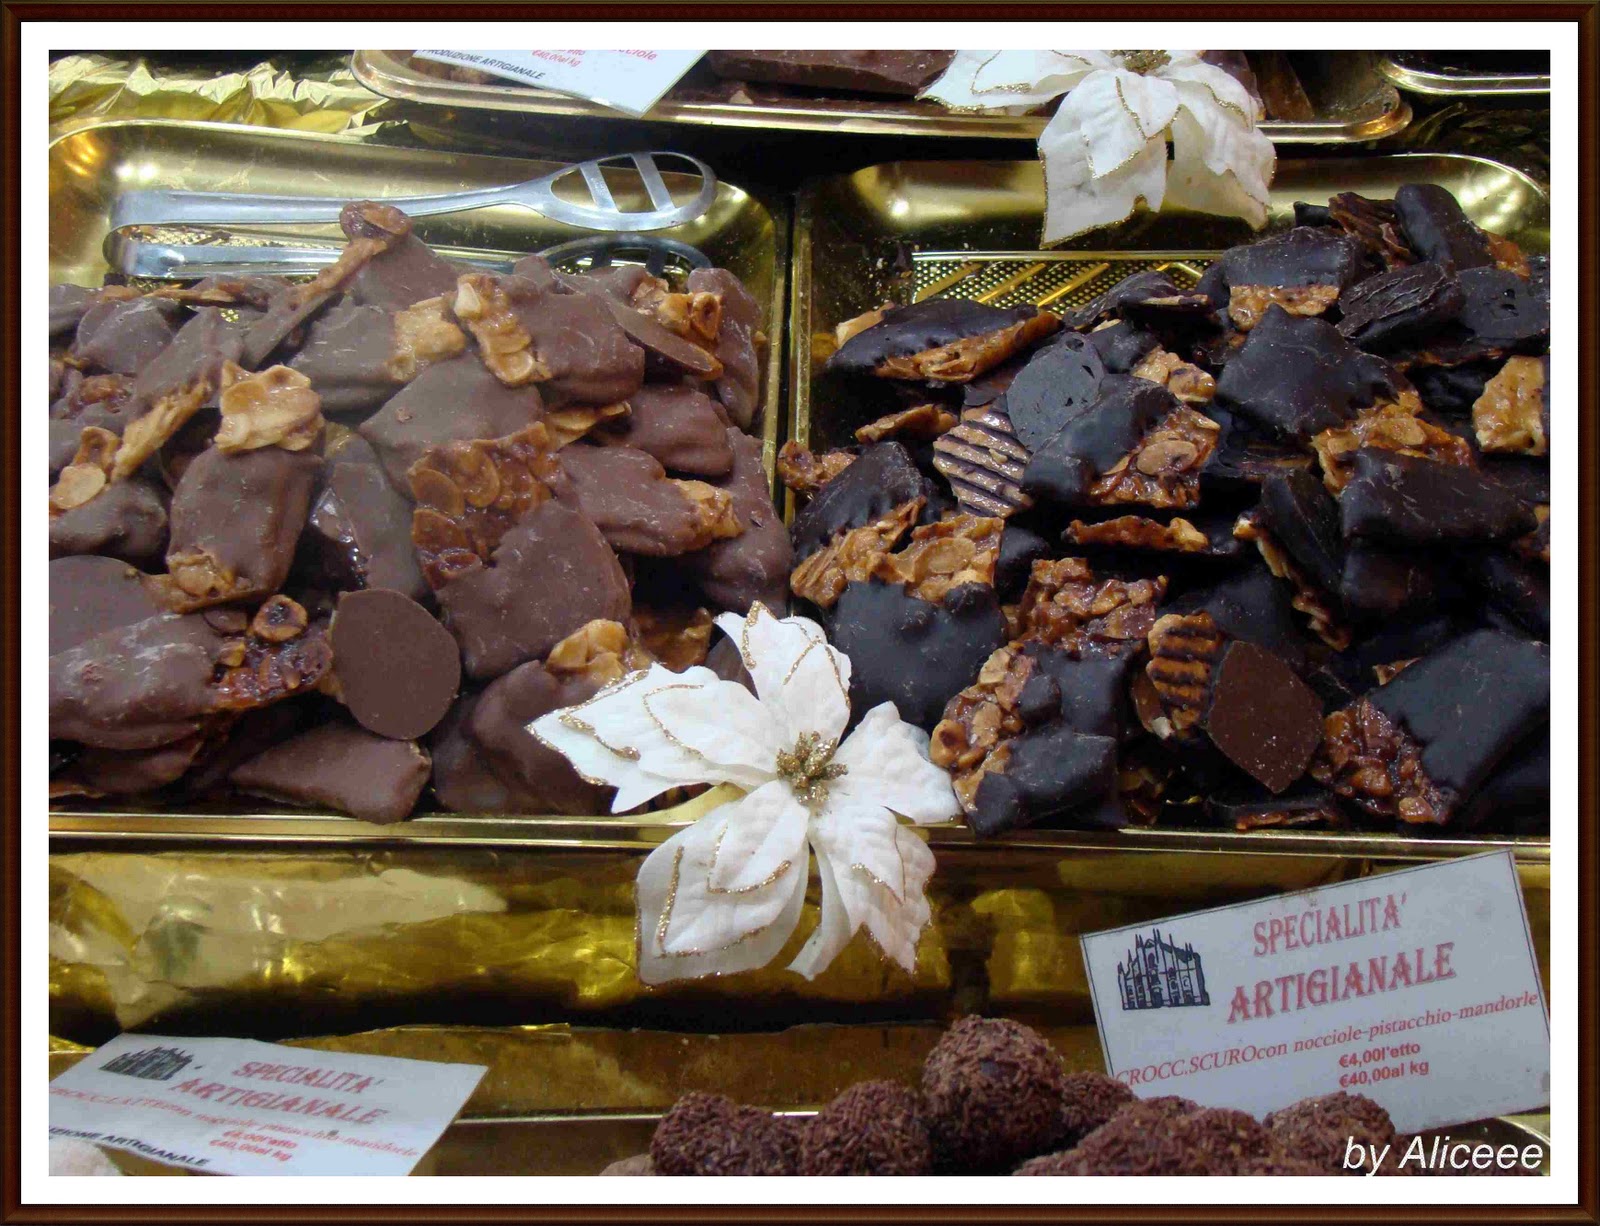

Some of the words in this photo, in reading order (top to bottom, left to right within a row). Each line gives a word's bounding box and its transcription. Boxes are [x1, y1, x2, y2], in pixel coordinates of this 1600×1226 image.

[480, 57, 547, 80] ARTIGIANALE
[567, 57, 582, 67] kg
[1253, 892, 1407, 958] SPECIALITA'
[1227, 941, 1457, 1025] ARTIGIANALE
[1294, 991, 1538, 1053] nocciole-pistacchio-mandorle
[1338, 1042, 1421, 1069] €4,00l'etto
[1338, 1063, 1405, 1089] €40,00al
[1409, 1060, 1430, 1076] kg
[168, 1077, 390, 1125] ARTIGIANALE
[102, 1135, 211, 1167] ARTIGIANALE
